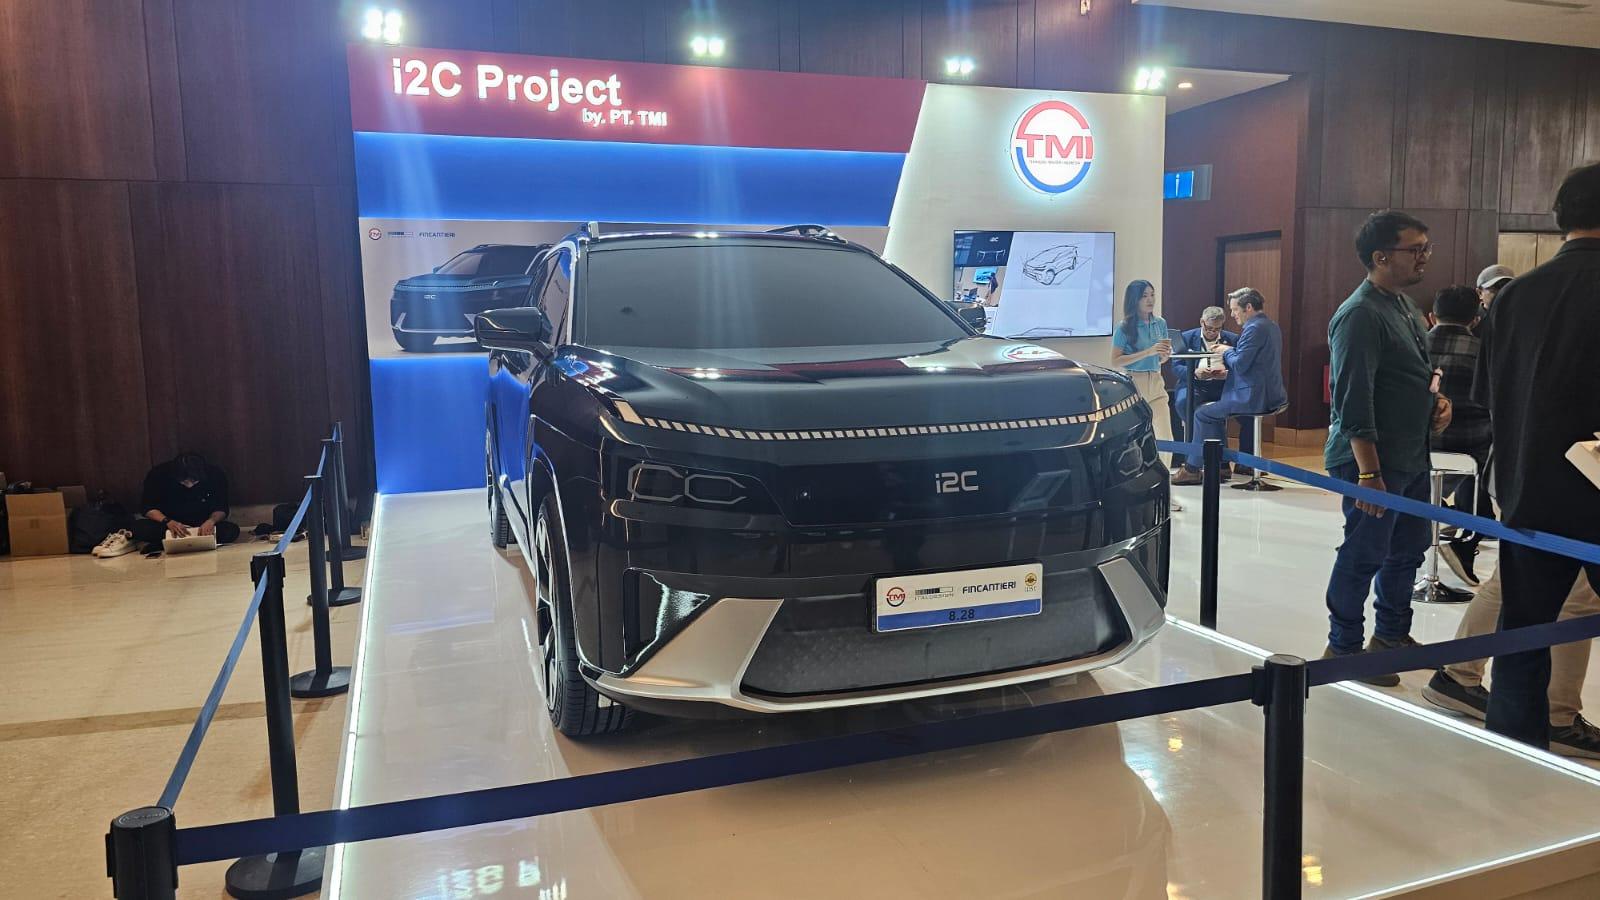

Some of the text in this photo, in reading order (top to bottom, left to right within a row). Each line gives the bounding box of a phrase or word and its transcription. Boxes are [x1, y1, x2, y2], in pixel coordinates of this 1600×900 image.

[392, 57, 622, 111] i2C Project
[582, 108, 667, 128] by. PT. TMI
[1016, 134, 1093, 159] TMI
[935, 470, 979, 494] i2C
[962, 581, 1016, 595] FINCANTIERI
[948, 609, 975, 621] 8.28
